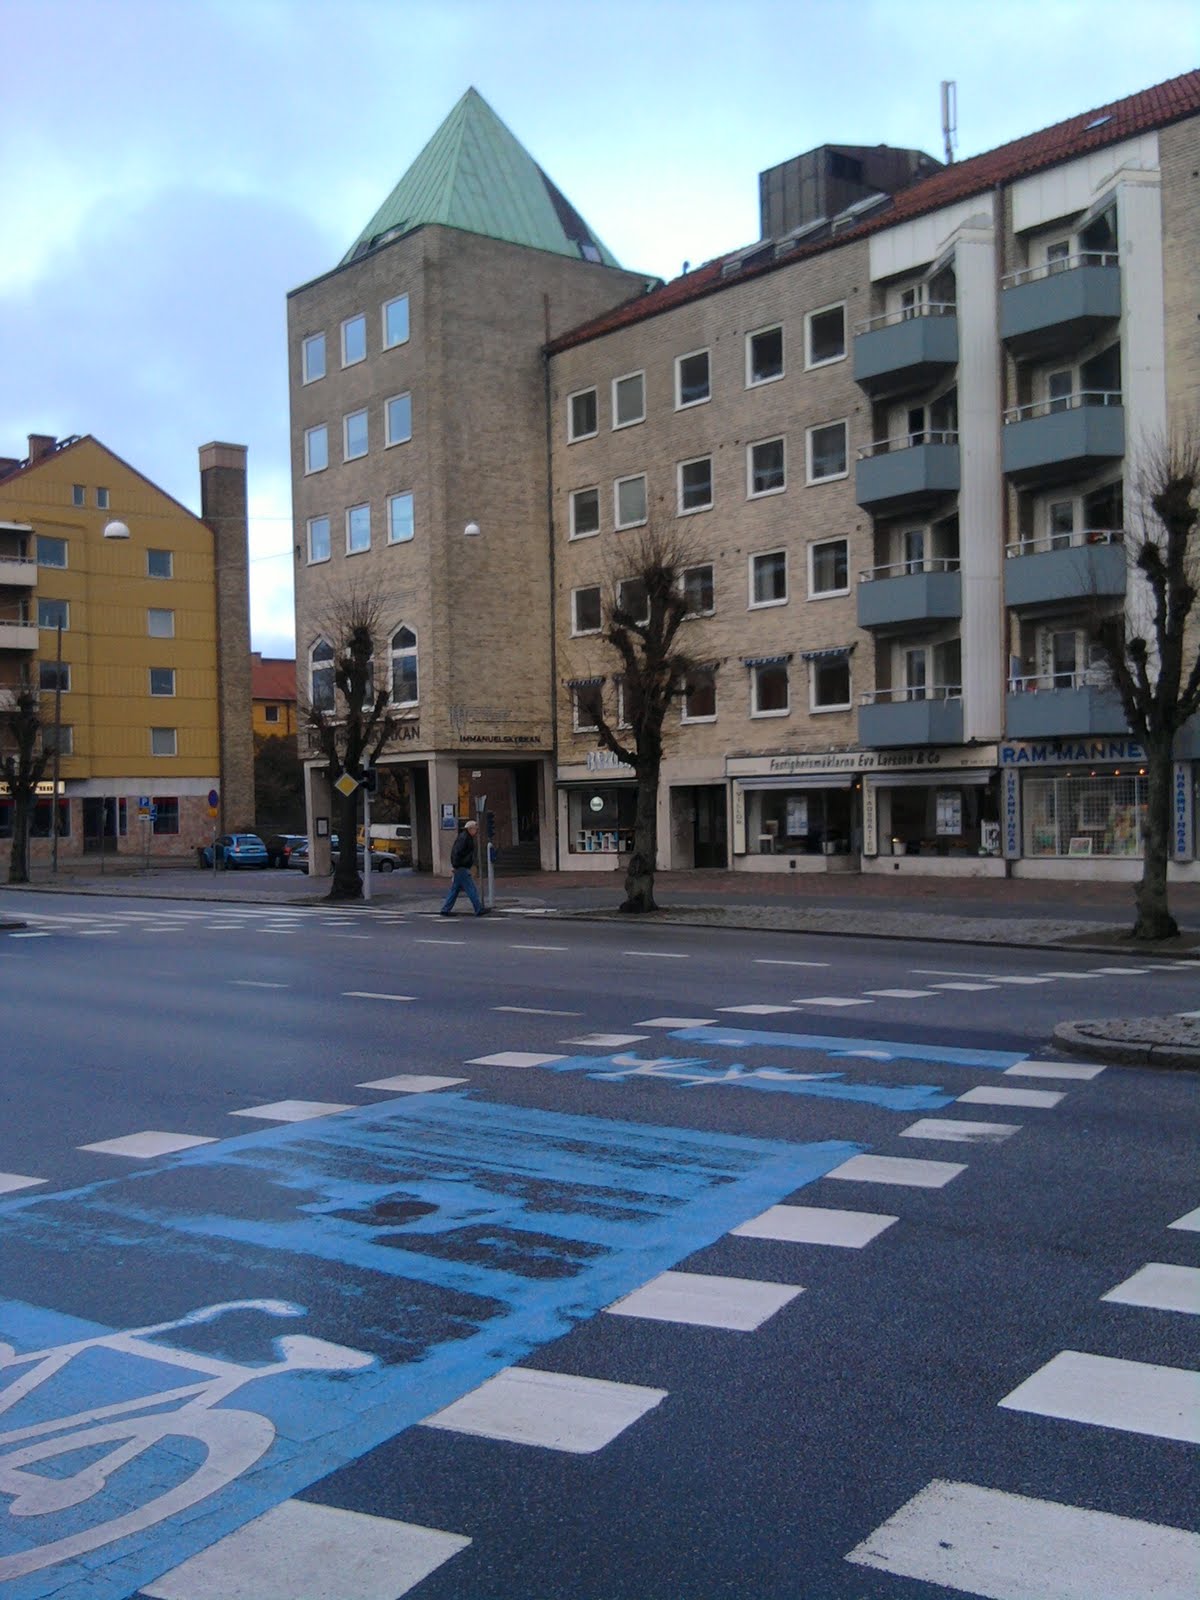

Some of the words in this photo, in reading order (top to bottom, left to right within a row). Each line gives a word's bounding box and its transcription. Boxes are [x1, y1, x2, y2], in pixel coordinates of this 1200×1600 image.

[857, 753, 874, 767] Eva
[916, 751, 925, 765] &
[927, 751, 941, 764] Co
[1002, 740, 1143, 763] RAM-MANNE
